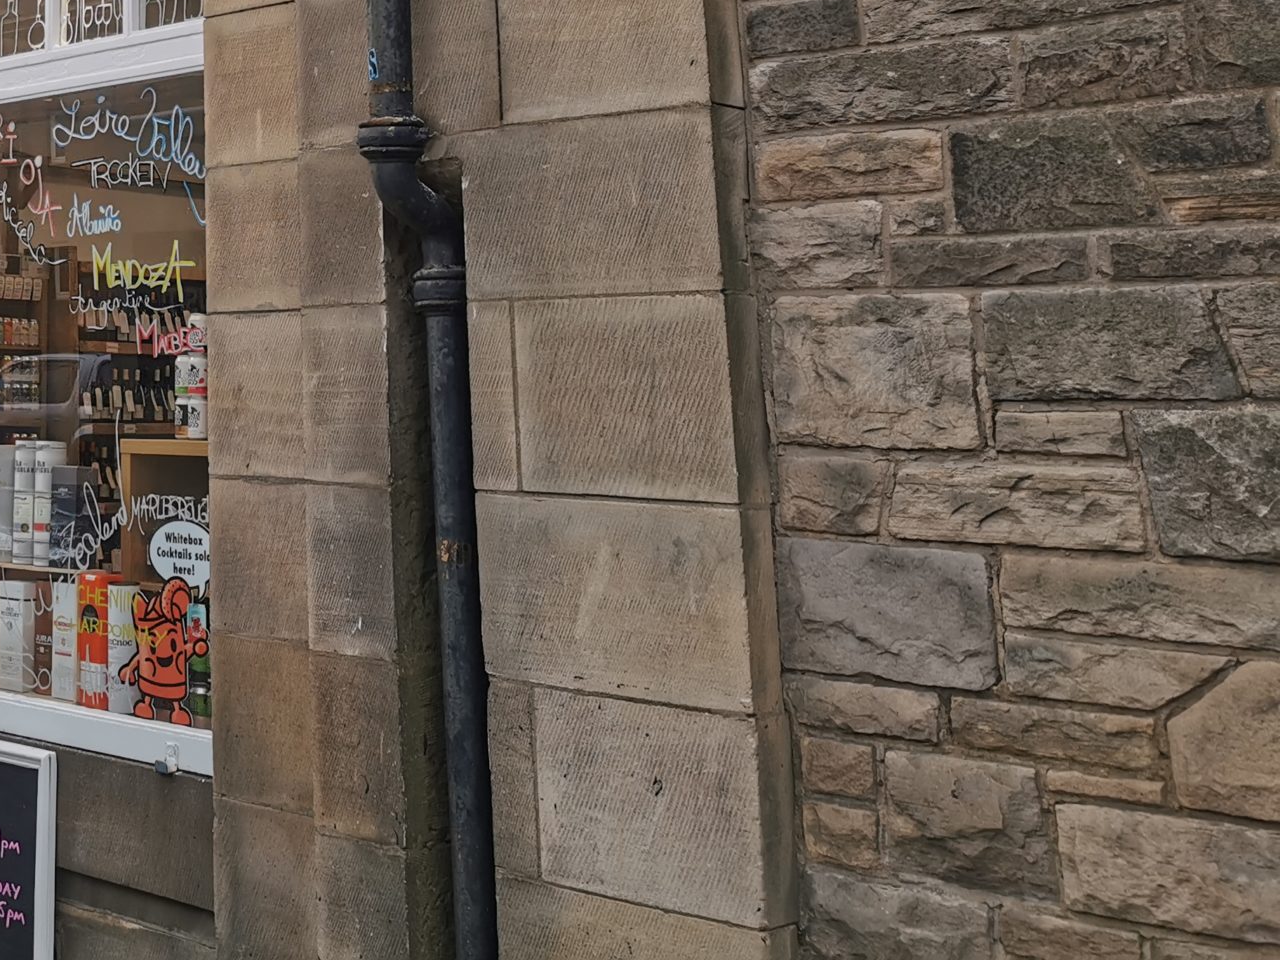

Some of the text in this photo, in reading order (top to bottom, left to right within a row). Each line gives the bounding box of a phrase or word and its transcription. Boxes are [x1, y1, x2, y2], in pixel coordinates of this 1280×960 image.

[53, 95, 138, 149] Loire
[91, 239, 197, 303] MENDOZA
[165, 531, 203, 546] Whitebox
[156, 546, 192, 560] Cocktails
[173, 562, 195, 576] here!
